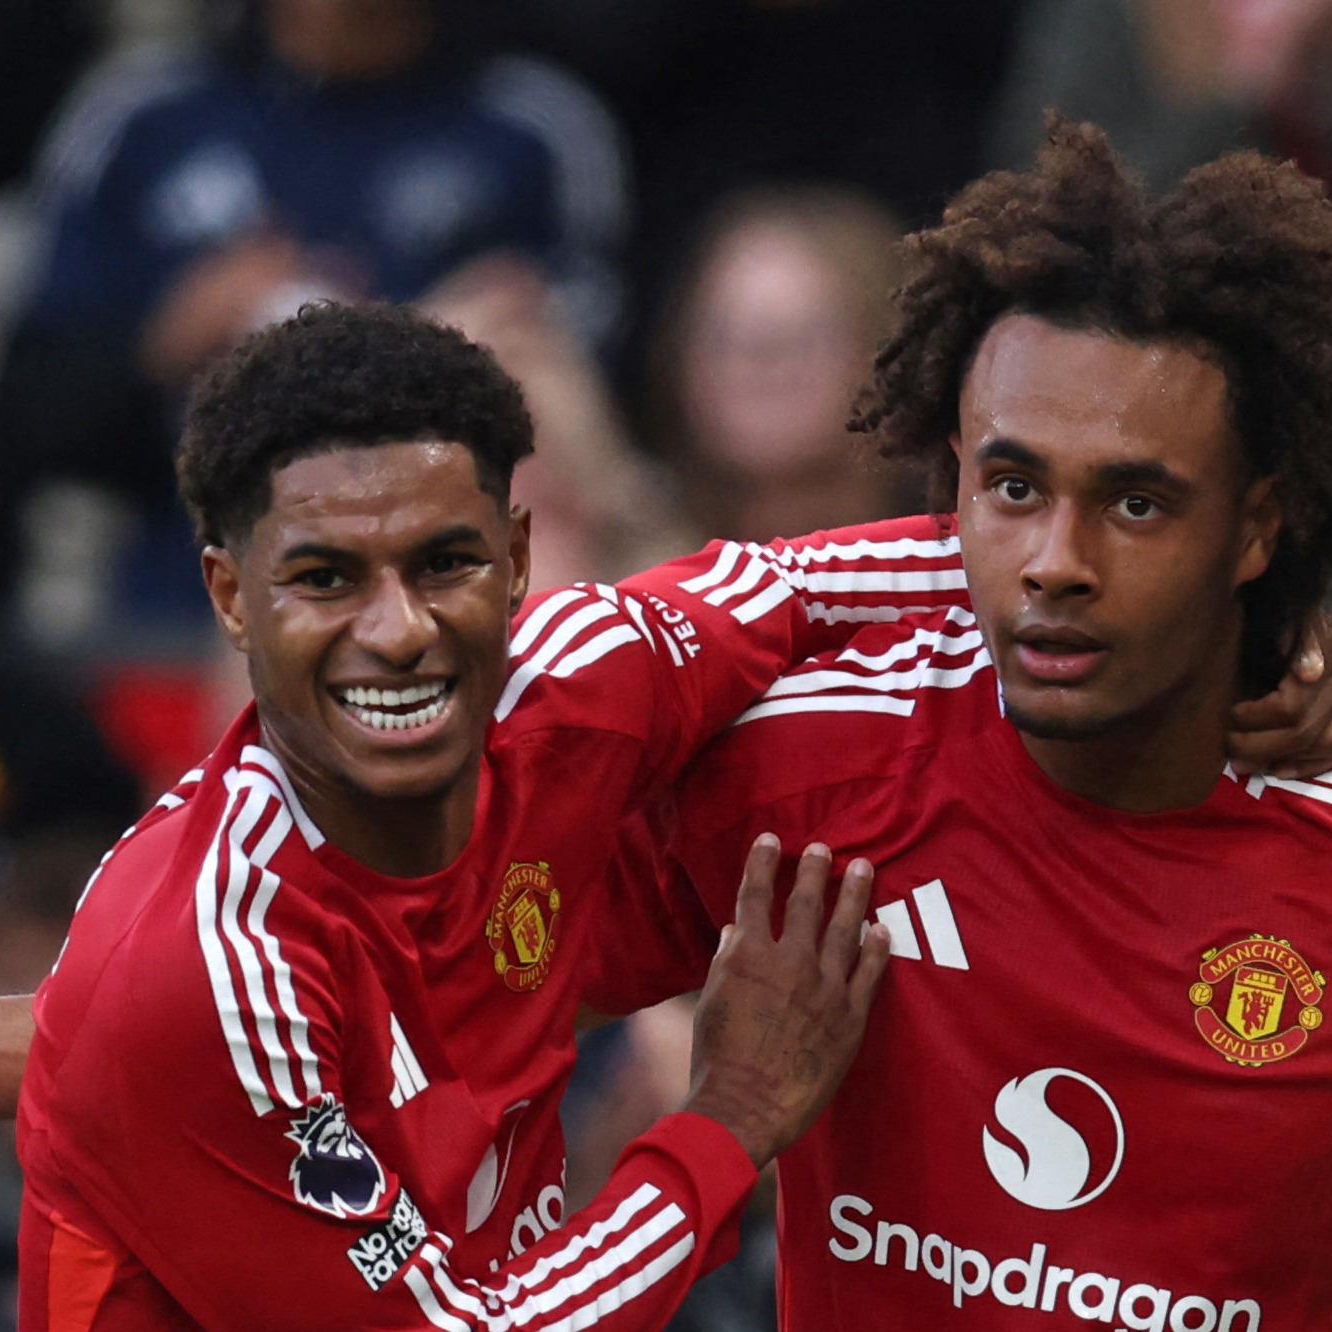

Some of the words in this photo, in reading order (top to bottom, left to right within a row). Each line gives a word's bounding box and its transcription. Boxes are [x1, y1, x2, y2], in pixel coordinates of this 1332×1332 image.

[493, 868, 548, 939] MANCHESTER
[1209, 943, 1315, 997] MANCHESTER
[1211, 1028, 1286, 1058] UNITED
[347, 1232, 387, 1273] No
[362, 1249, 398, 1291] for
